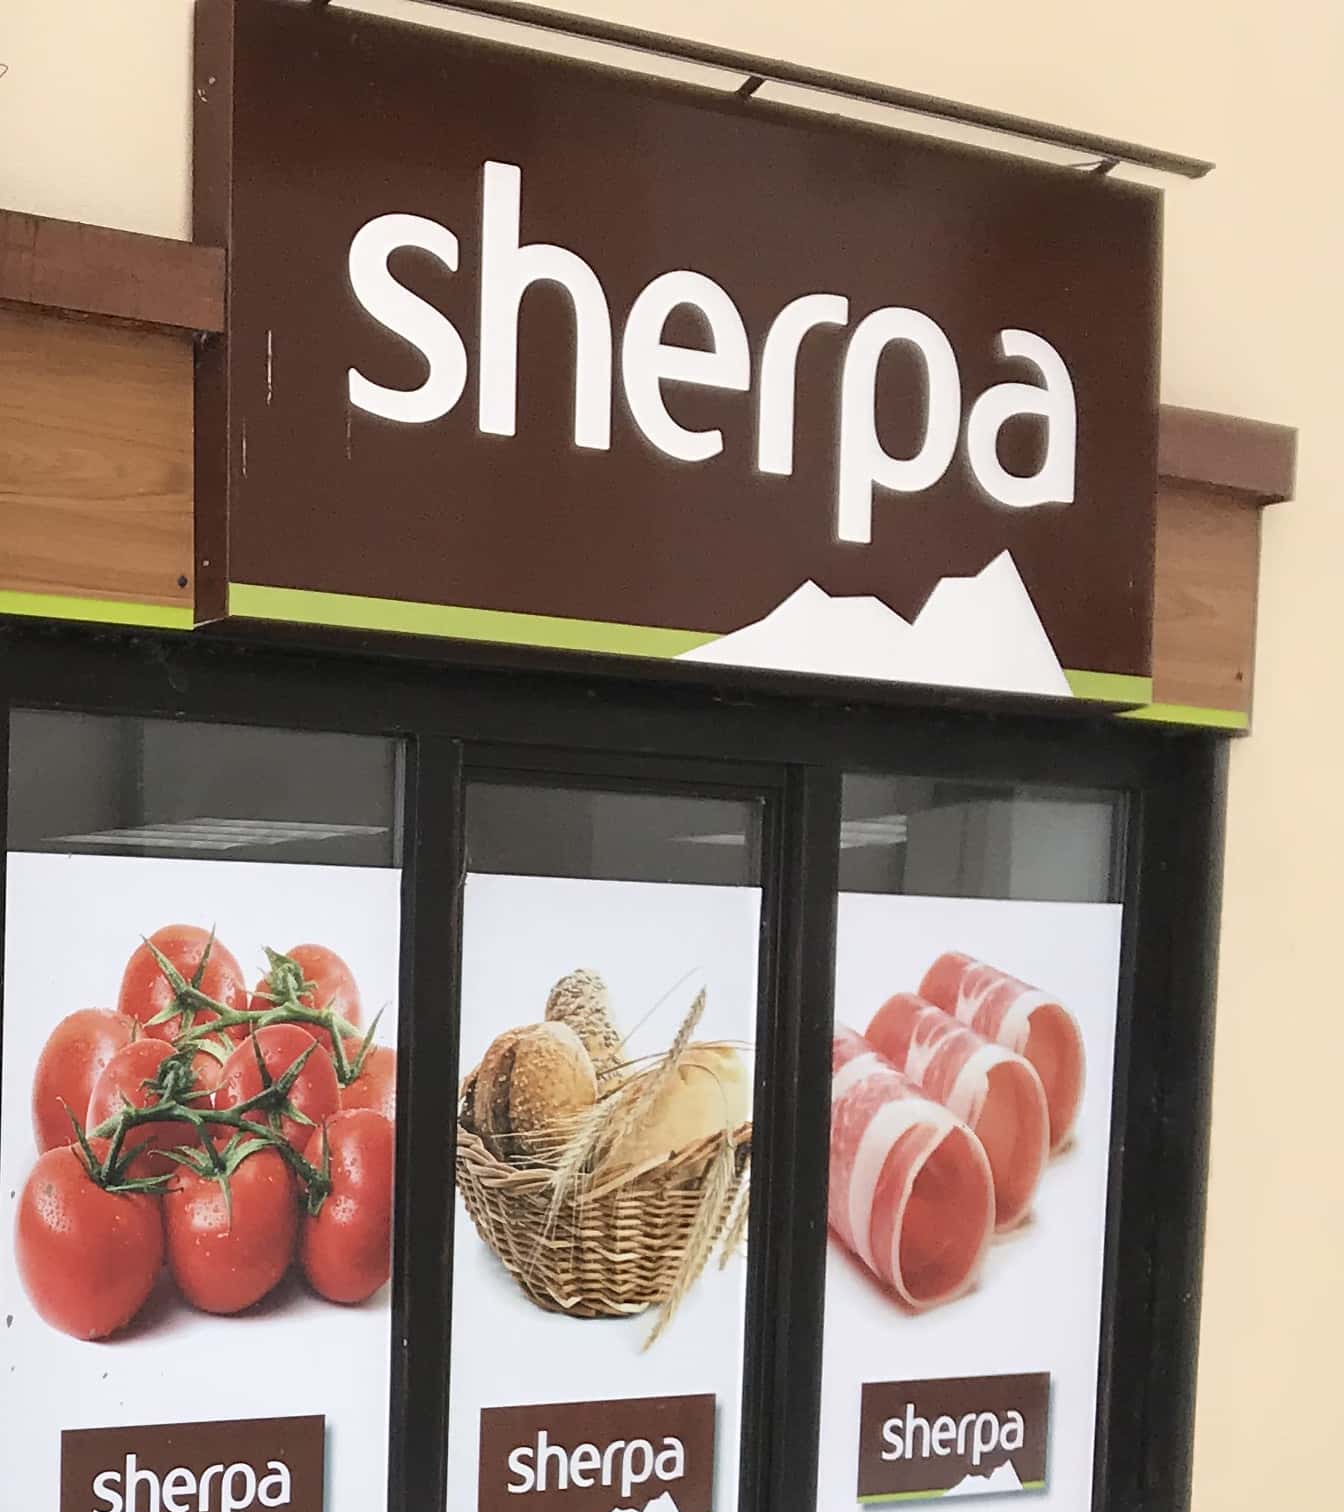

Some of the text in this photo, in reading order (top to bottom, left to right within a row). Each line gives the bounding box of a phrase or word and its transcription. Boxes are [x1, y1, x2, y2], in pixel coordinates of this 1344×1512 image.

[349, 160, 1079, 543] sherpa
[505, 1429, 687, 1501] sherpa
[879, 1402, 1027, 1466] sherpa
